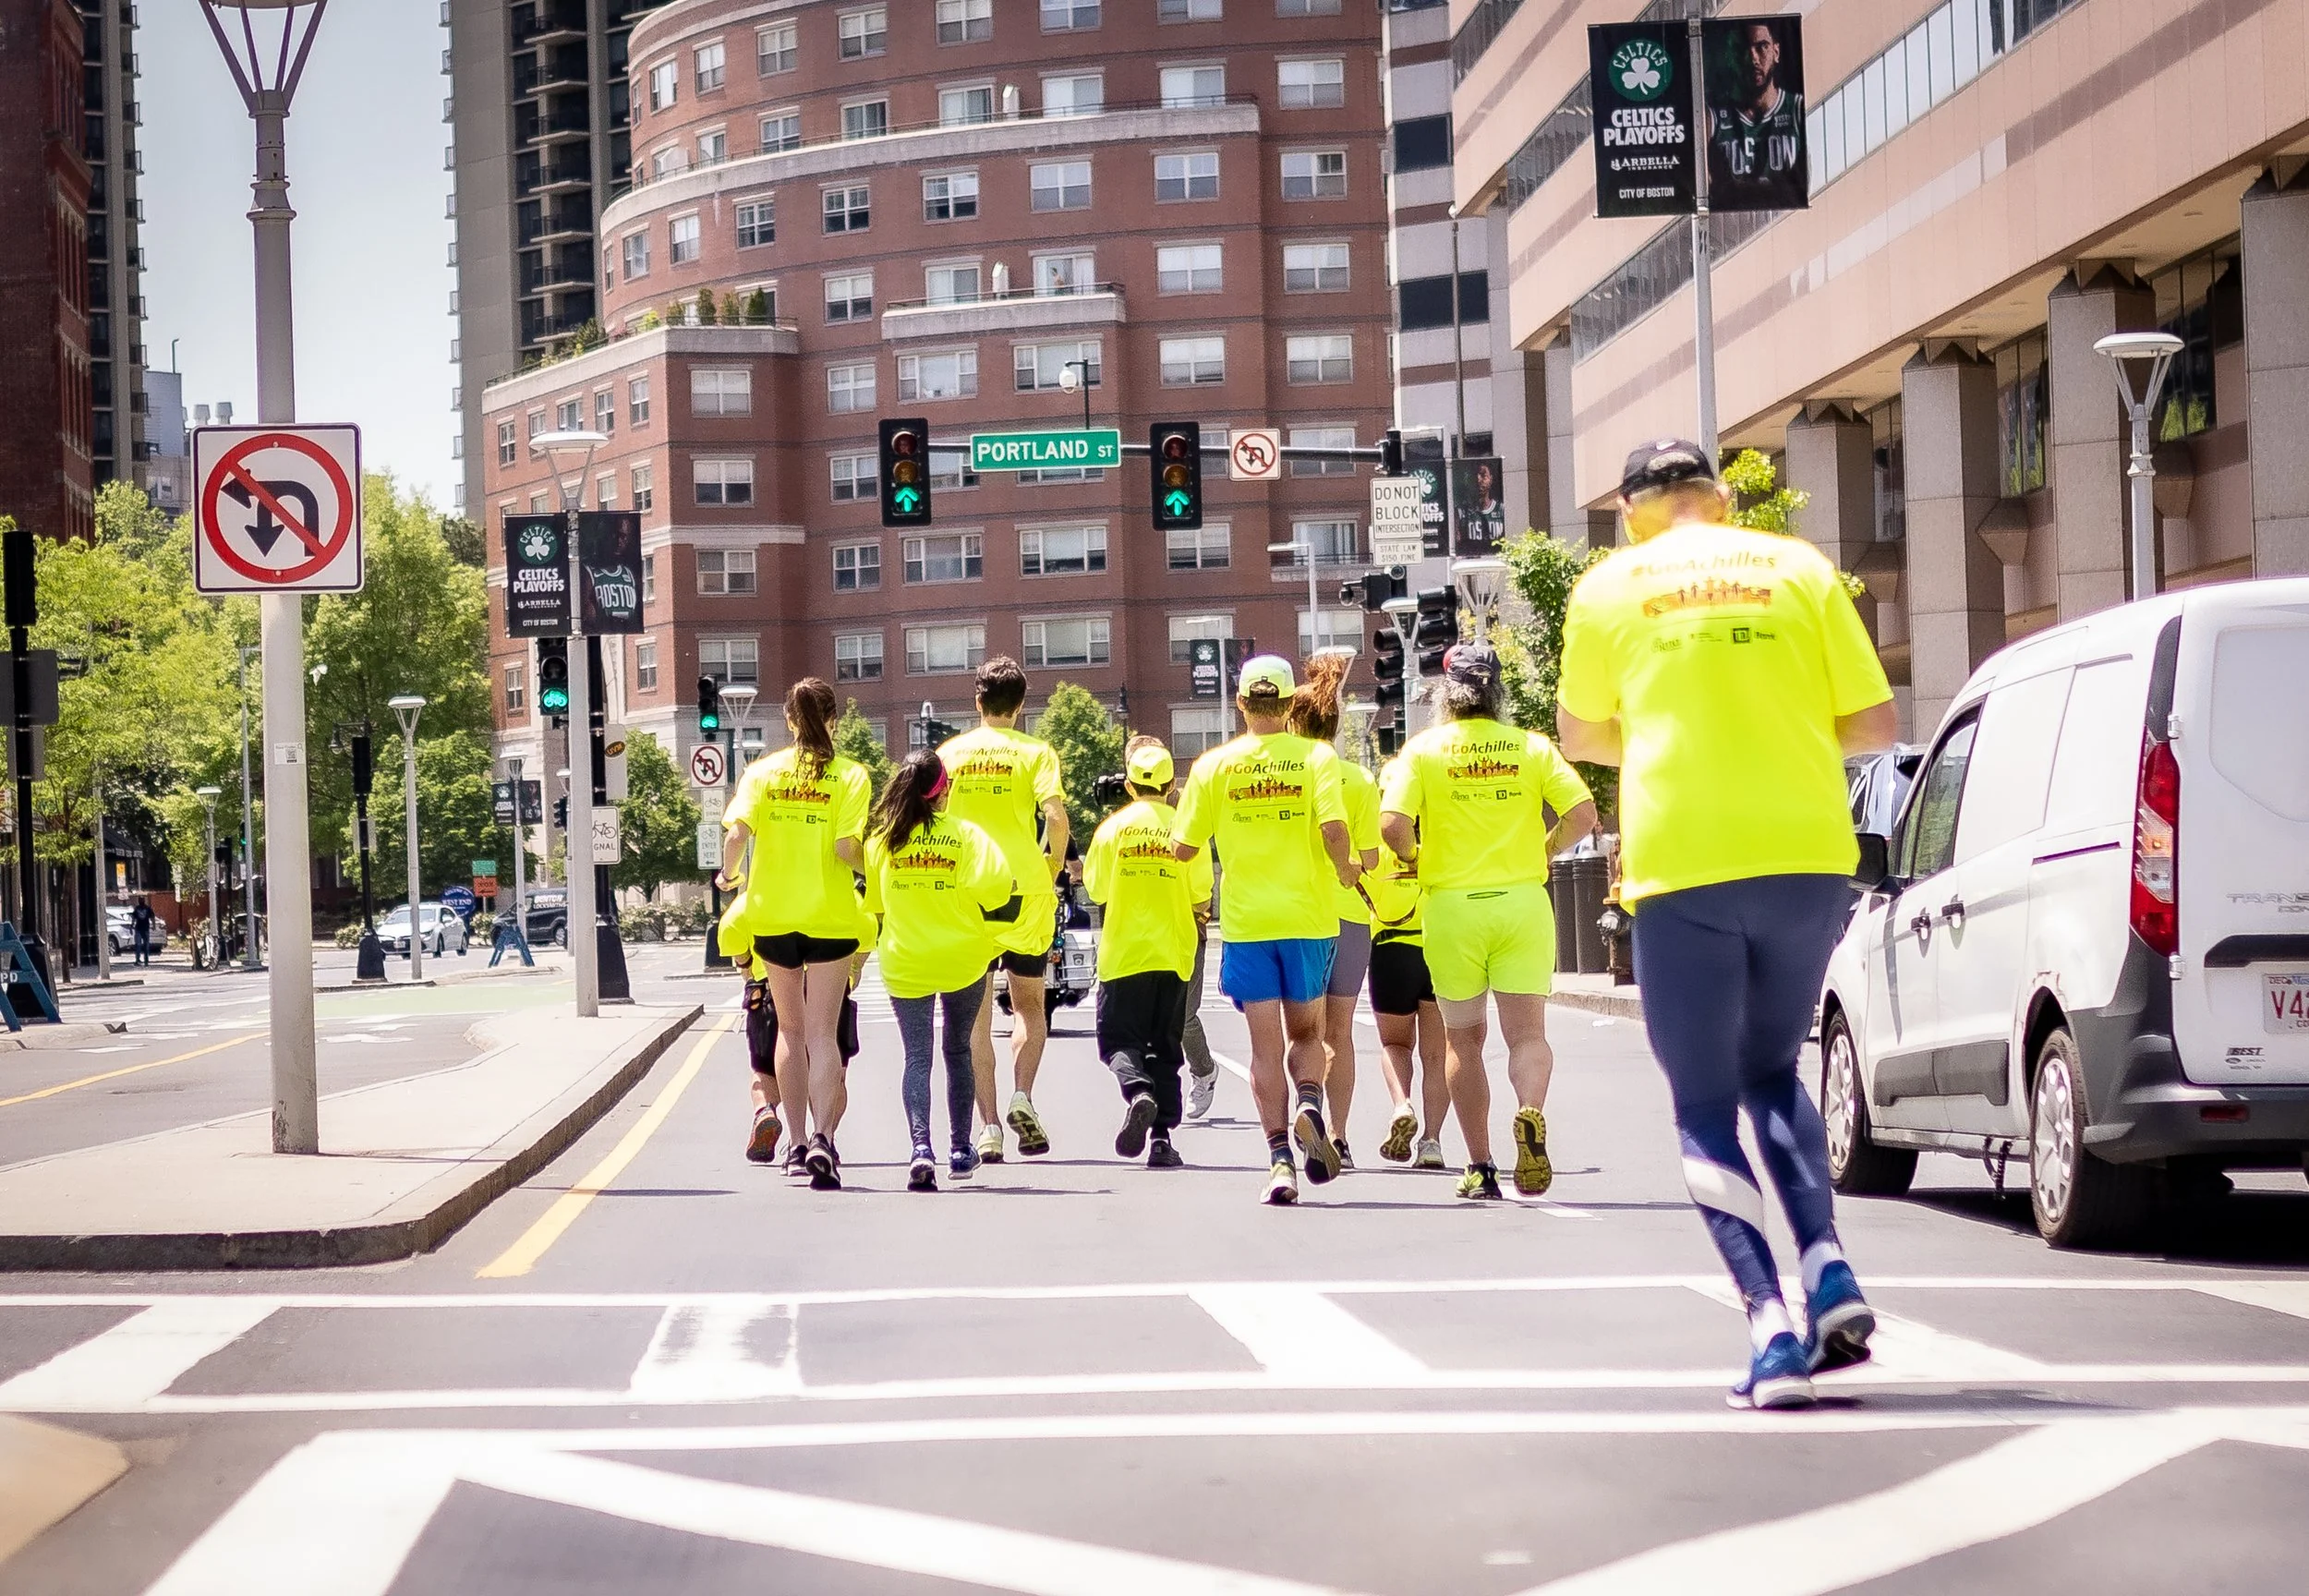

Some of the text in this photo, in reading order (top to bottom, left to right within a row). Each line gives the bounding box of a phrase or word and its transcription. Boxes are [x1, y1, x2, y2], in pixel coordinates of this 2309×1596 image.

[1613, 42, 1668, 68] CELTICS
[1611, 107, 1675, 127] CELTICS
[1603, 125, 1685, 146] PLAYOFFS
[1621, 156, 1680, 167] ARBELLA
[1619, 186, 1674, 200] CITY OF BOSTON
[977, 440, 1114, 462] PORTLAND ST
[1374, 486, 1418, 500] DO NOT
[1375, 505, 1419, 520] BLOCK
[519, 526, 554, 543] CELTICS
[1375, 524, 1420, 533] INTERSECTION
[518, 567, 559, 581] CELTICS
[514, 579, 564, 593] PLAYOFFS
[1443, 741, 1520, 755] #GoAchilles
[1225, 760, 1304, 776] #GoAchilles
[593, 842, 616, 851] GNAL
[910, 835, 962, 849] Achilles
[2271, 990, 2309, 1020] V4
